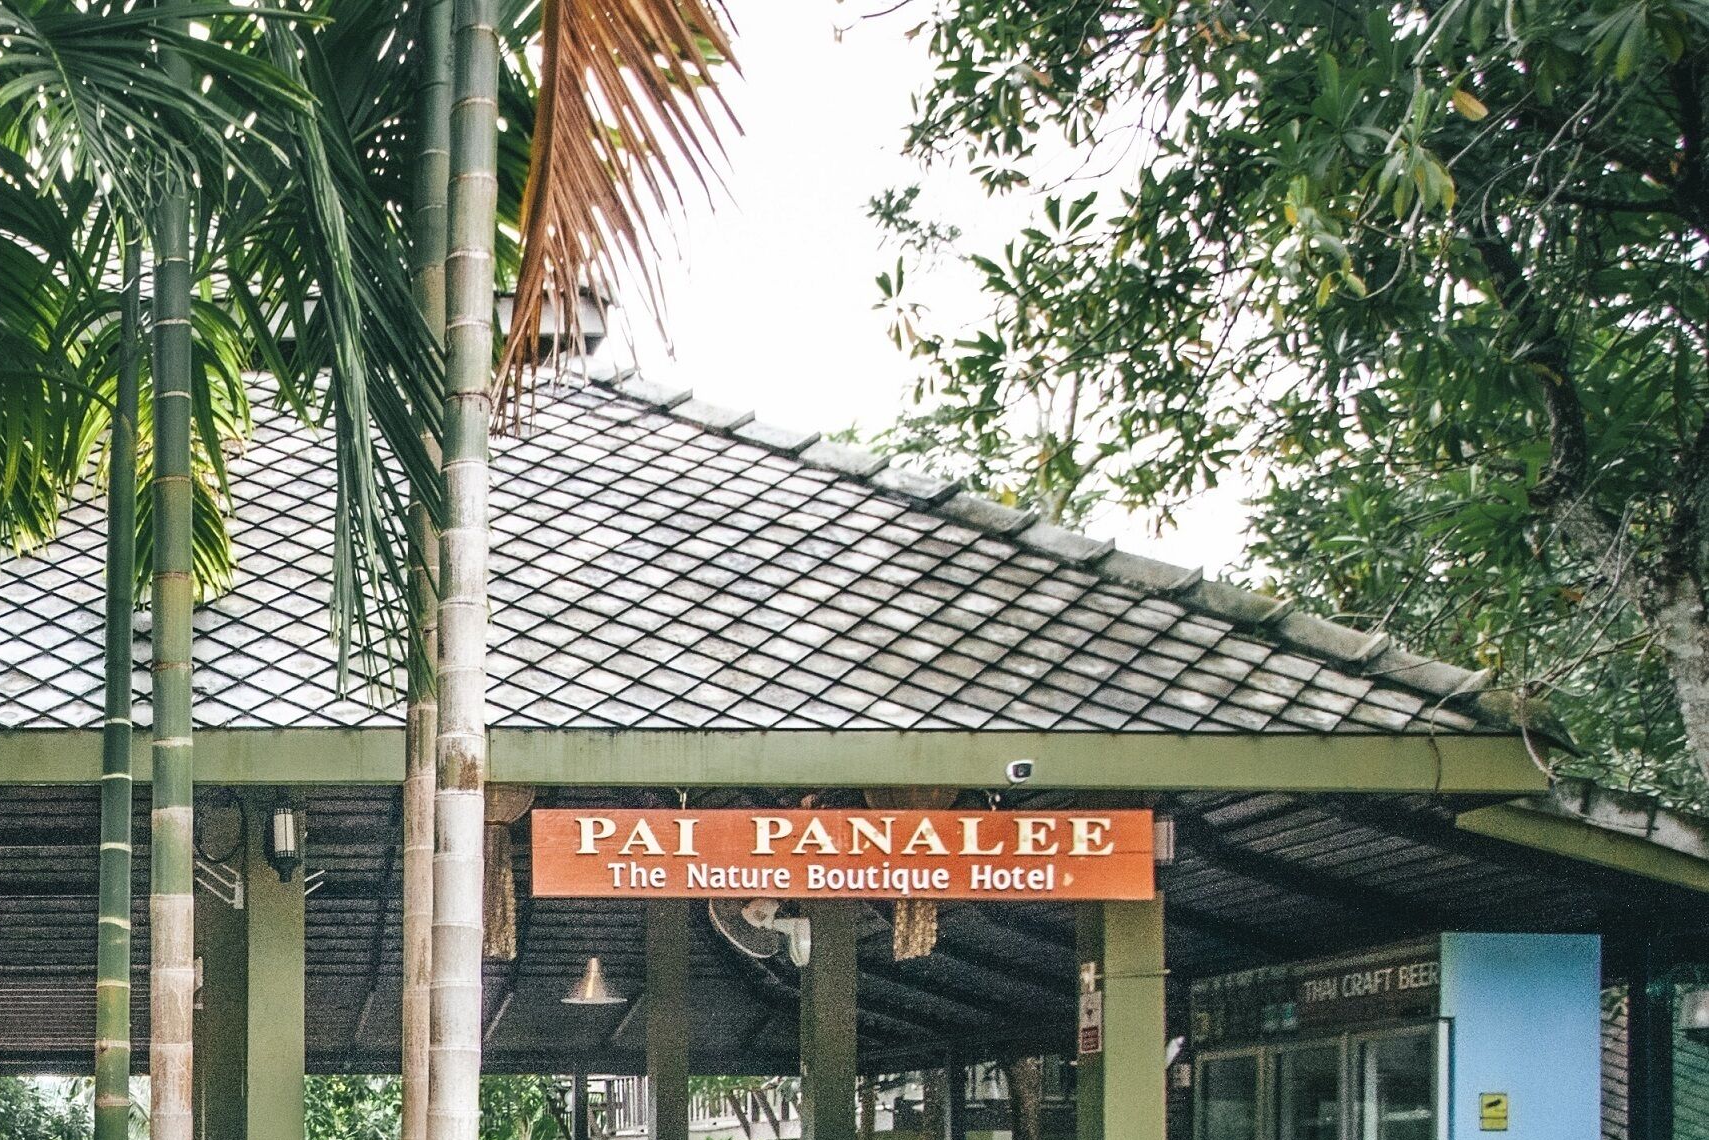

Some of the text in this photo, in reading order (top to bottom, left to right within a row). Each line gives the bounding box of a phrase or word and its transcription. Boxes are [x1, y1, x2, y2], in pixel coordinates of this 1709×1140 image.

[574, 817, 1115, 856] PAI PANALEE
[607, 862, 1055, 895] The Nature Boutique Hotel
[1342, 967, 1395, 998] CRAFT
[1397, 960, 1439, 990] BEER
